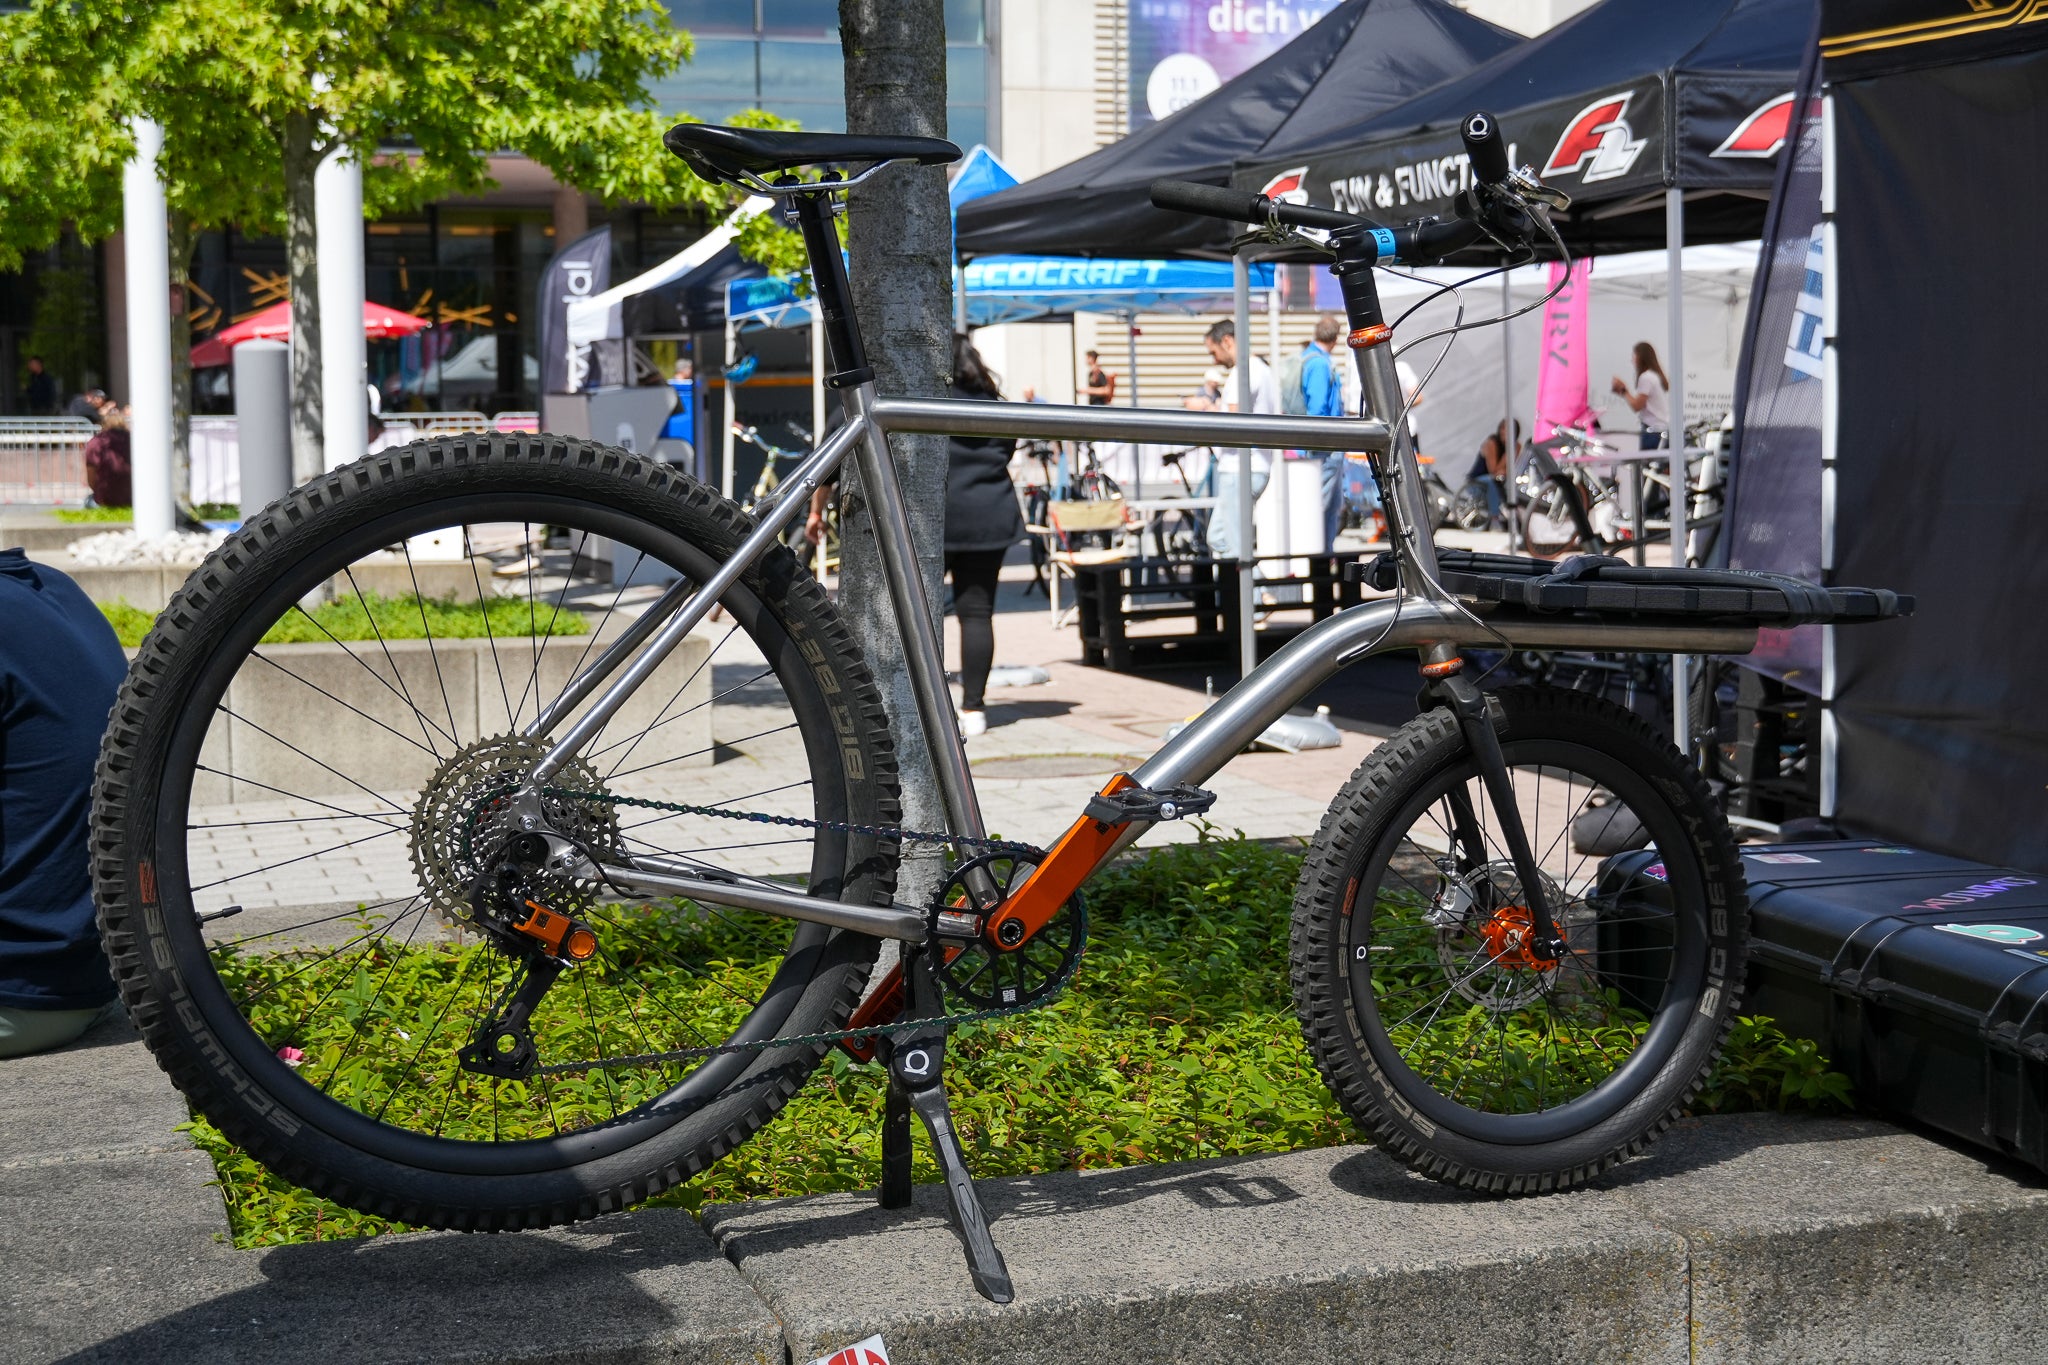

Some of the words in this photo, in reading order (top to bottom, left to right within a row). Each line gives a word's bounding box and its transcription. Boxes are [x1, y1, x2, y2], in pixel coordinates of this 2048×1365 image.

[1207, 0, 1291, 34] dich
[1329, 173, 1374, 215] FUN
[1374, 173, 1395, 209] &
[1394, 142, 1517, 206] FUNCT
[952, 259, 1167, 288] ECOCRAFT
[831, 704, 866, 781] BIG
[1698, 946, 1728, 1020] BIG
[143, 904, 303, 1139] SCHWALBE
[1337, 916, 1438, 1141] SCHWALBE
